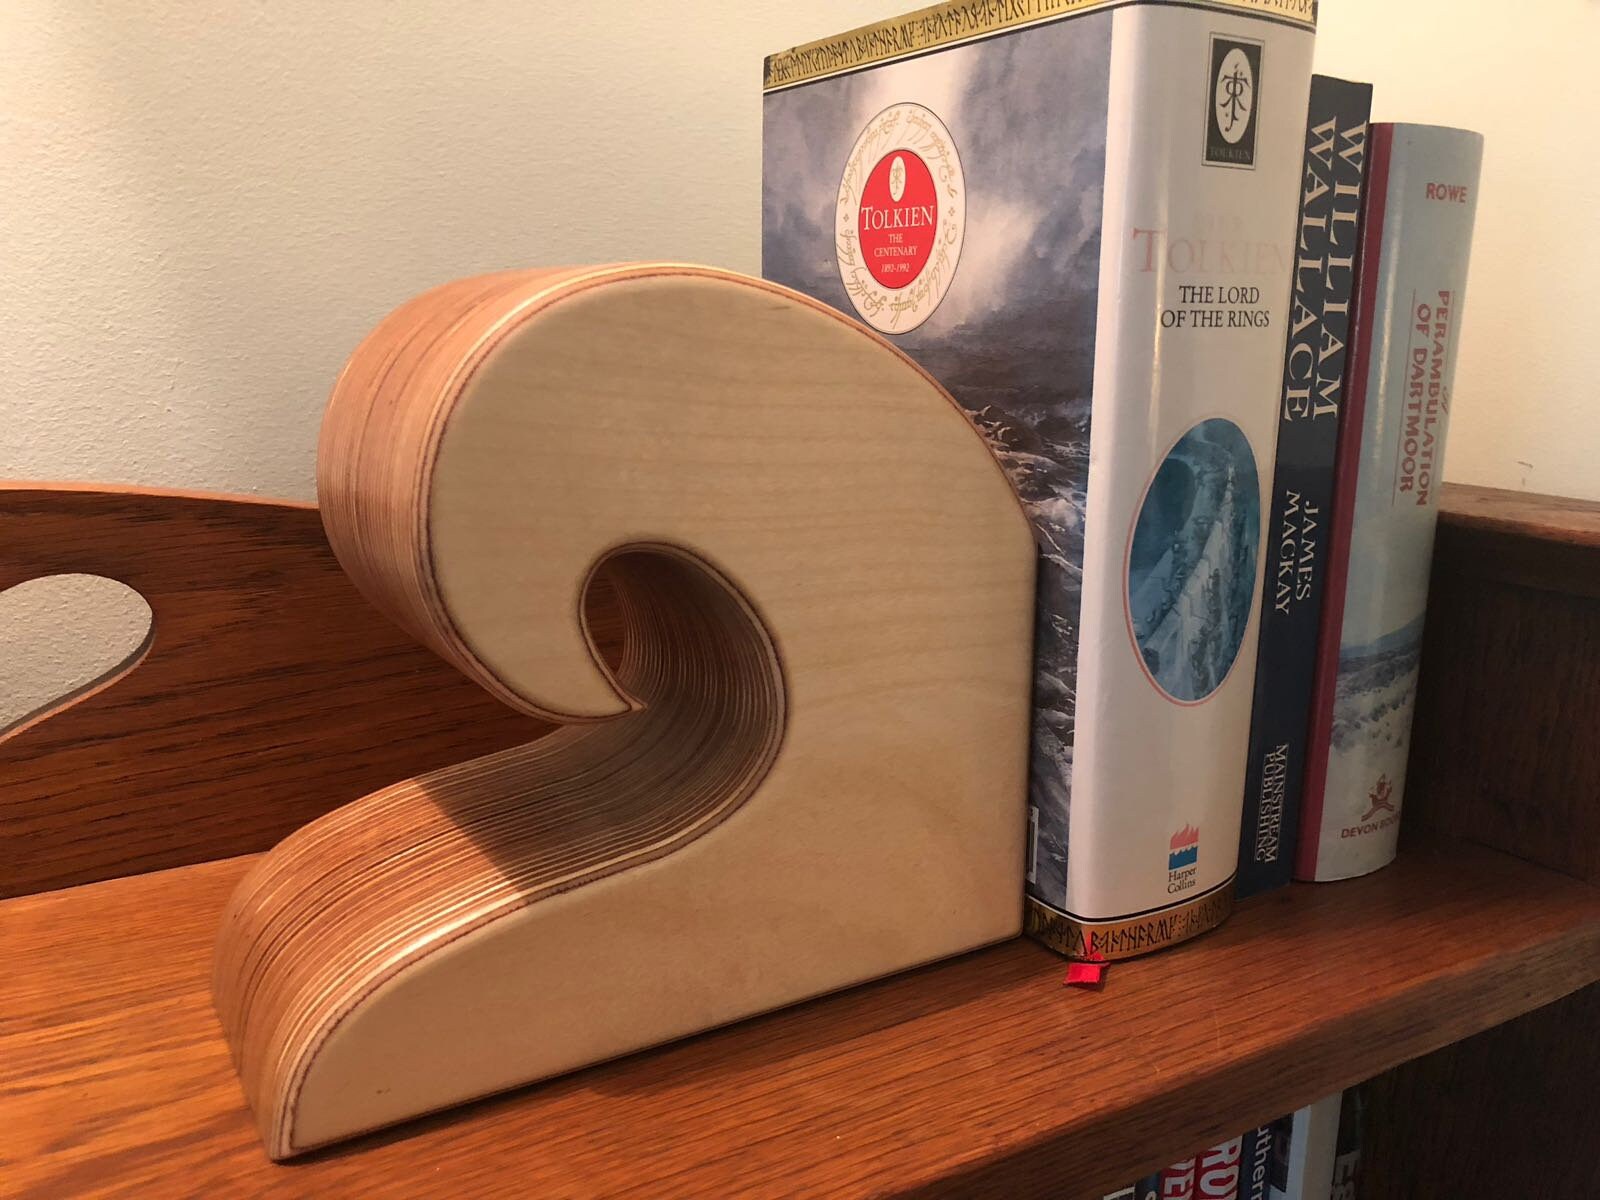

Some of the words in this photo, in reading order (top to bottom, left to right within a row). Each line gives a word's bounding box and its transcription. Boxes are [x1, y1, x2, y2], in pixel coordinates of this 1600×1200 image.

[1426, 182, 1467, 204] ROWE
[861, 205, 935, 230] TOLKIEN
[873, 245, 918, 257] CENTENARY
[887, 233, 903, 244] THE
[1284, 115, 1337, 421] WALLACE
[1312, 120, 1369, 420] WILLIAM
[1178, 285, 1214, 304] THE
[1217, 286, 1260, 305] LORD
[1160, 309, 1186, 328] OF
[1190, 310, 1223, 328] THE
[1228, 310, 1270, 328] RINGS
[1415, 303, 1431, 338] OF
[1416, 290, 1450, 506] PERAMBULATION
[1400, 348, 1428, 493] DARTMOOR
[1275, 489, 1301, 615] MACKAY
[1295, 500, 1319, 601] JAMES
[1256, 752, 1276, 862] PUBLISHING
[1264, 743, 1289, 864] MAINSTREAM
[1340, 822, 1378, 839] DEVON
[1167, 878, 1196, 894] Collins
[1168, 867, 1197, 883] Harper
